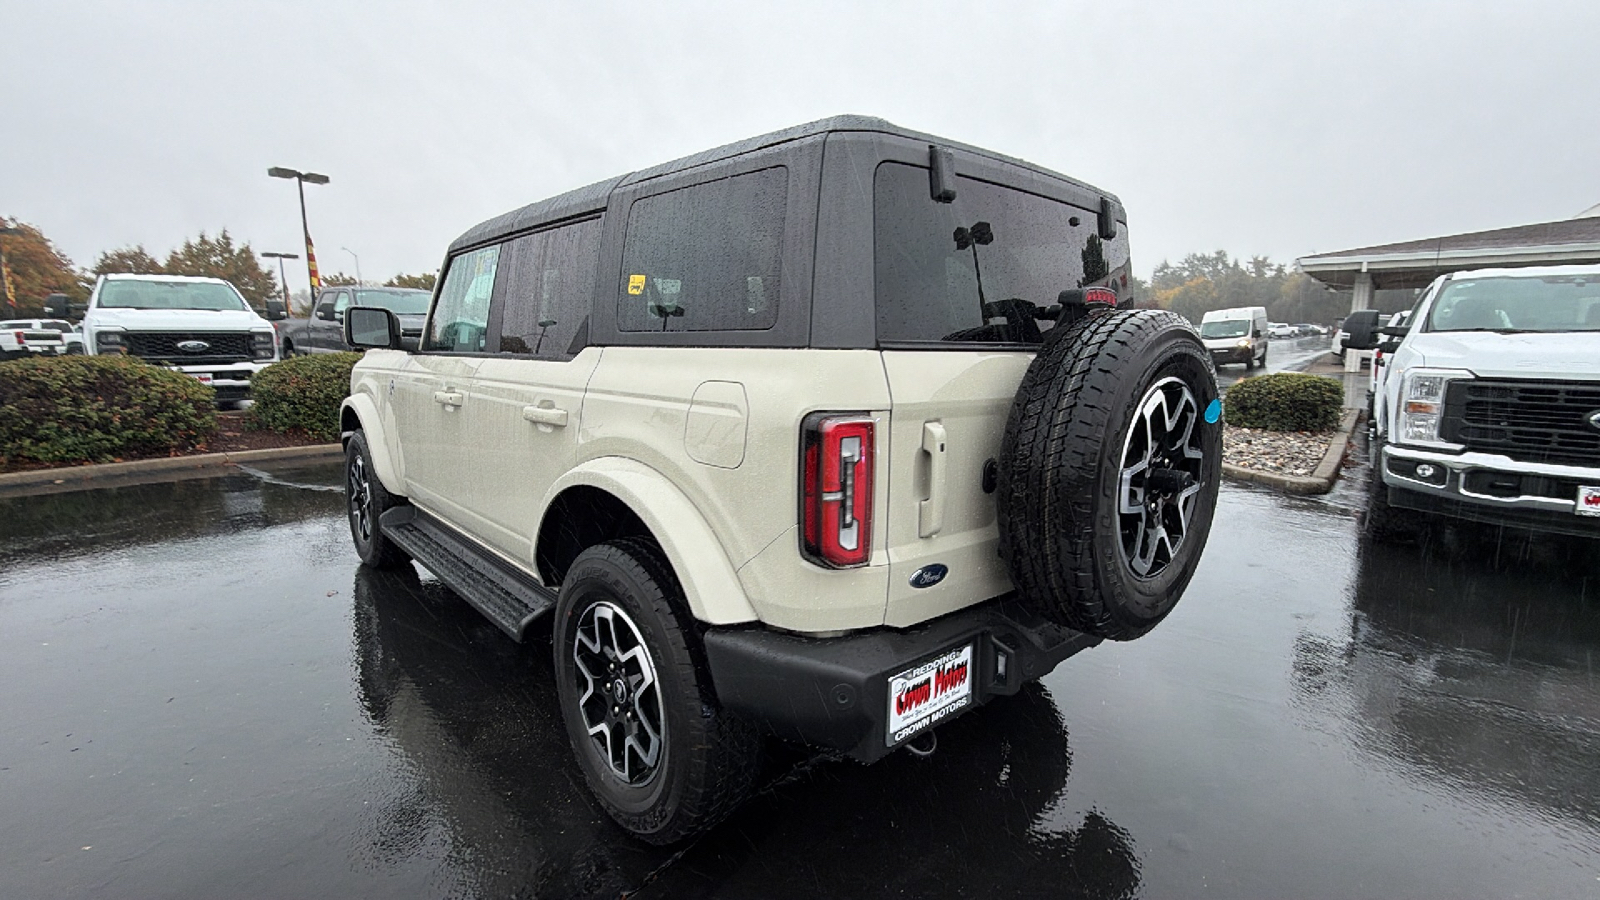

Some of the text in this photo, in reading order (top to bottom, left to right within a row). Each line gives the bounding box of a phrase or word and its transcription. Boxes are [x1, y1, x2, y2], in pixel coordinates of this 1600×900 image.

[913, 651, 956, 677] REDDING
[895, 676, 931, 716] Crown
[934, 658, 968, 699] Motors
[895, 717, 930, 741] CROWN
[931, 697, 968, 722] MOTORS
